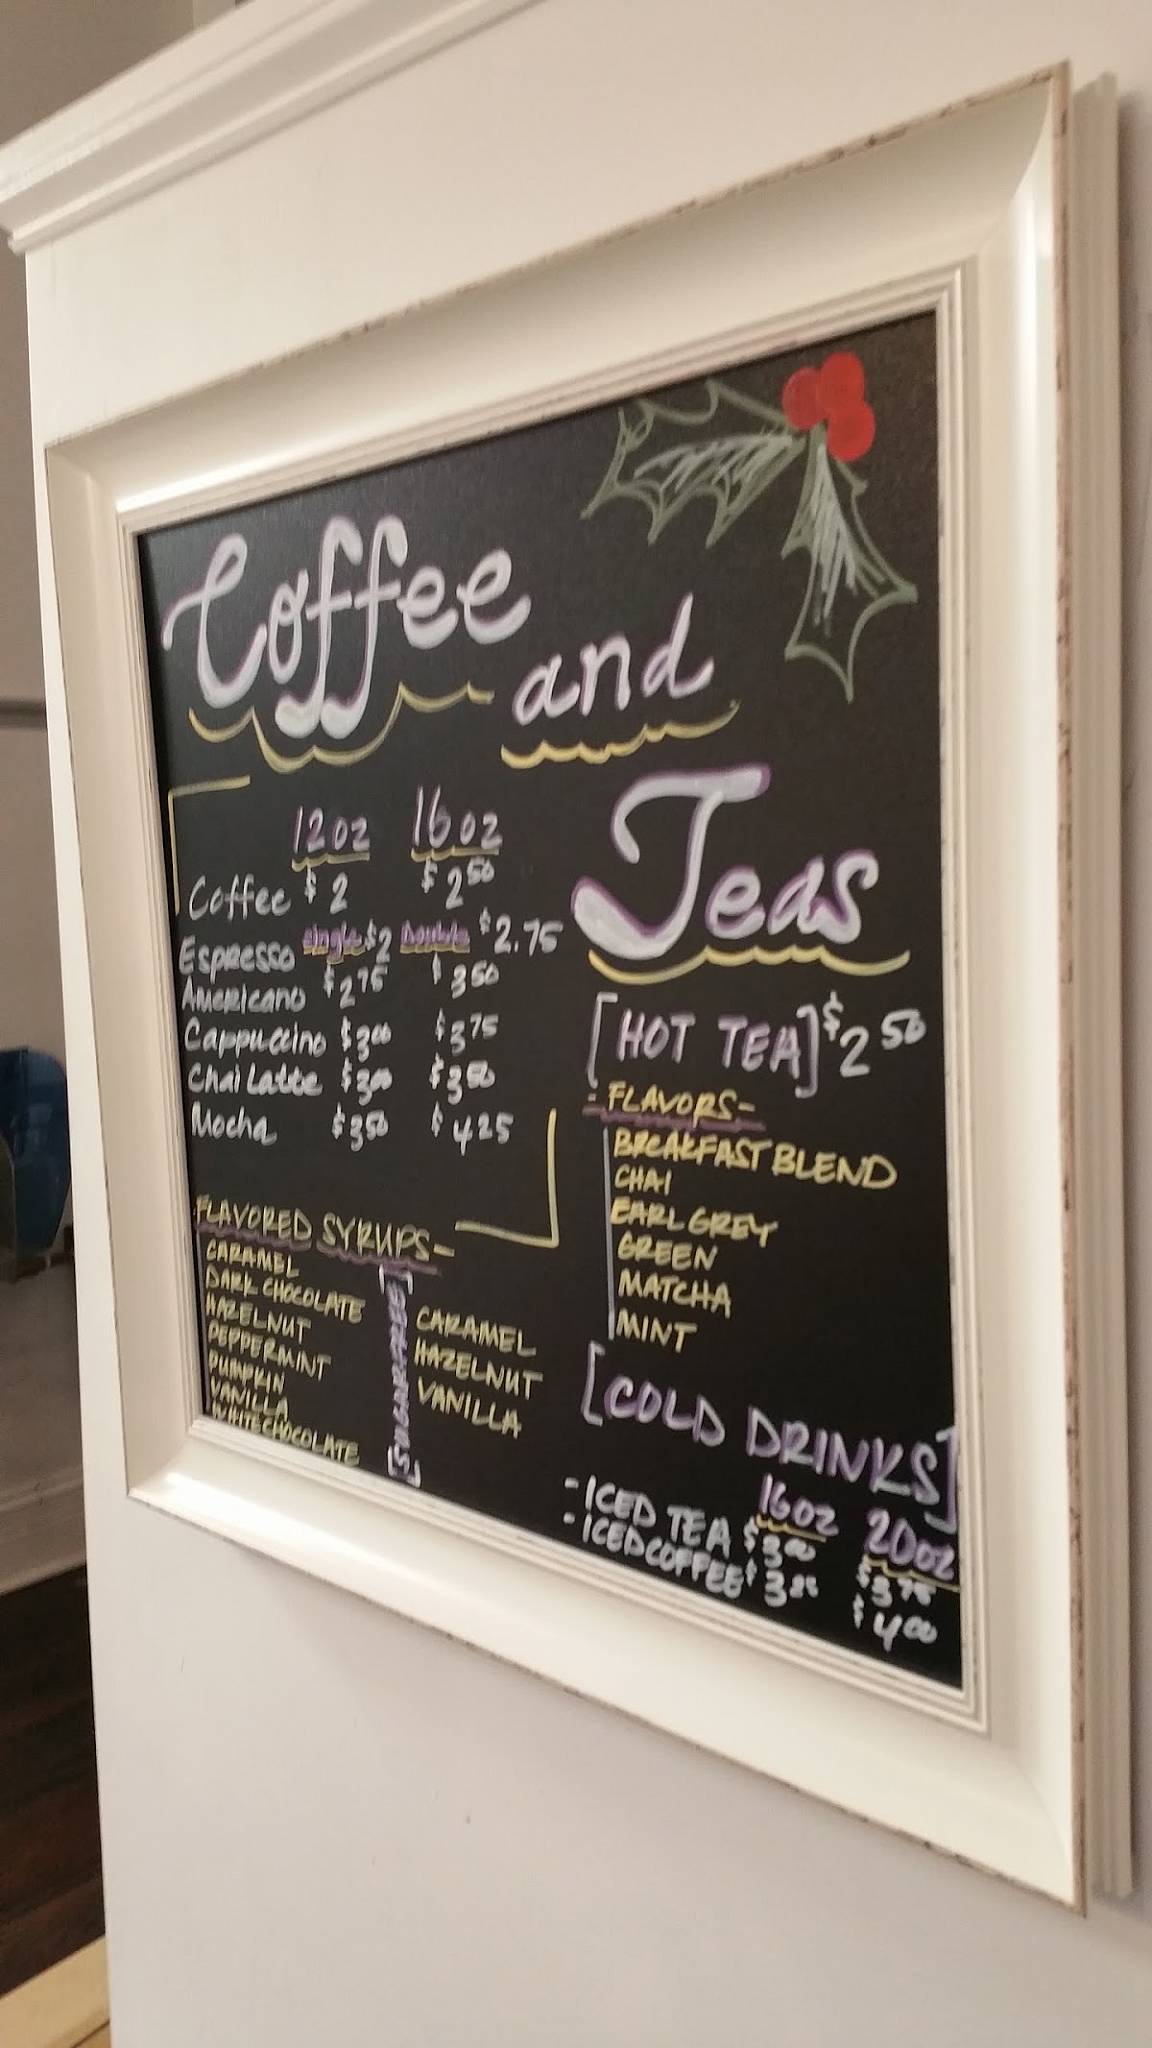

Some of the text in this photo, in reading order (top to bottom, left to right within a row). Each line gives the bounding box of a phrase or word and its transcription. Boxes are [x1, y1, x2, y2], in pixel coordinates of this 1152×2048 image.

[162, 514, 531, 739] Coffee
[512, 592, 715, 726] and
[571, 763, 879, 961] Teas
[188, 873, 292, 921] Coffee
[178, 935, 296, 984] Espresso
[181, 976, 306, 1013] Americano
[187, 1062, 240, 1095] Chai
[247, 1062, 323, 1096] Latte
[191, 1101, 277, 1146] Mocha
[613, 1127, 898, 1190] BREAKFAST BLEND
[614, 1164, 672, 1195] CHAI
[194, 1194, 313, 1242] FLAVORED
[610, 1196, 779, 1248] EARL GREY
[206, 1239, 300, 1278] CARAMEL
[617, 1231, 718, 1271] GREEN
[205, 1263, 367, 1324] DARK CHOCOLATE
[205, 1292, 312, 1344] HAZELNUT
[618, 1268, 732, 1319] MATCHA
[207, 1320, 332, 1381] PEPPERMINT
[416, 1304, 537, 1357] CARAMEL
[615, 1308, 698, 1353] MINT
[208, 1349, 285, 1394] PUMPKIN
[414, 1337, 544, 1400] HAZELNUT
[210, 1375, 290, 1423] VANILLA
[418, 1376, 523, 1439] VANILLA
[667, 1503, 731, 1559] TEA
